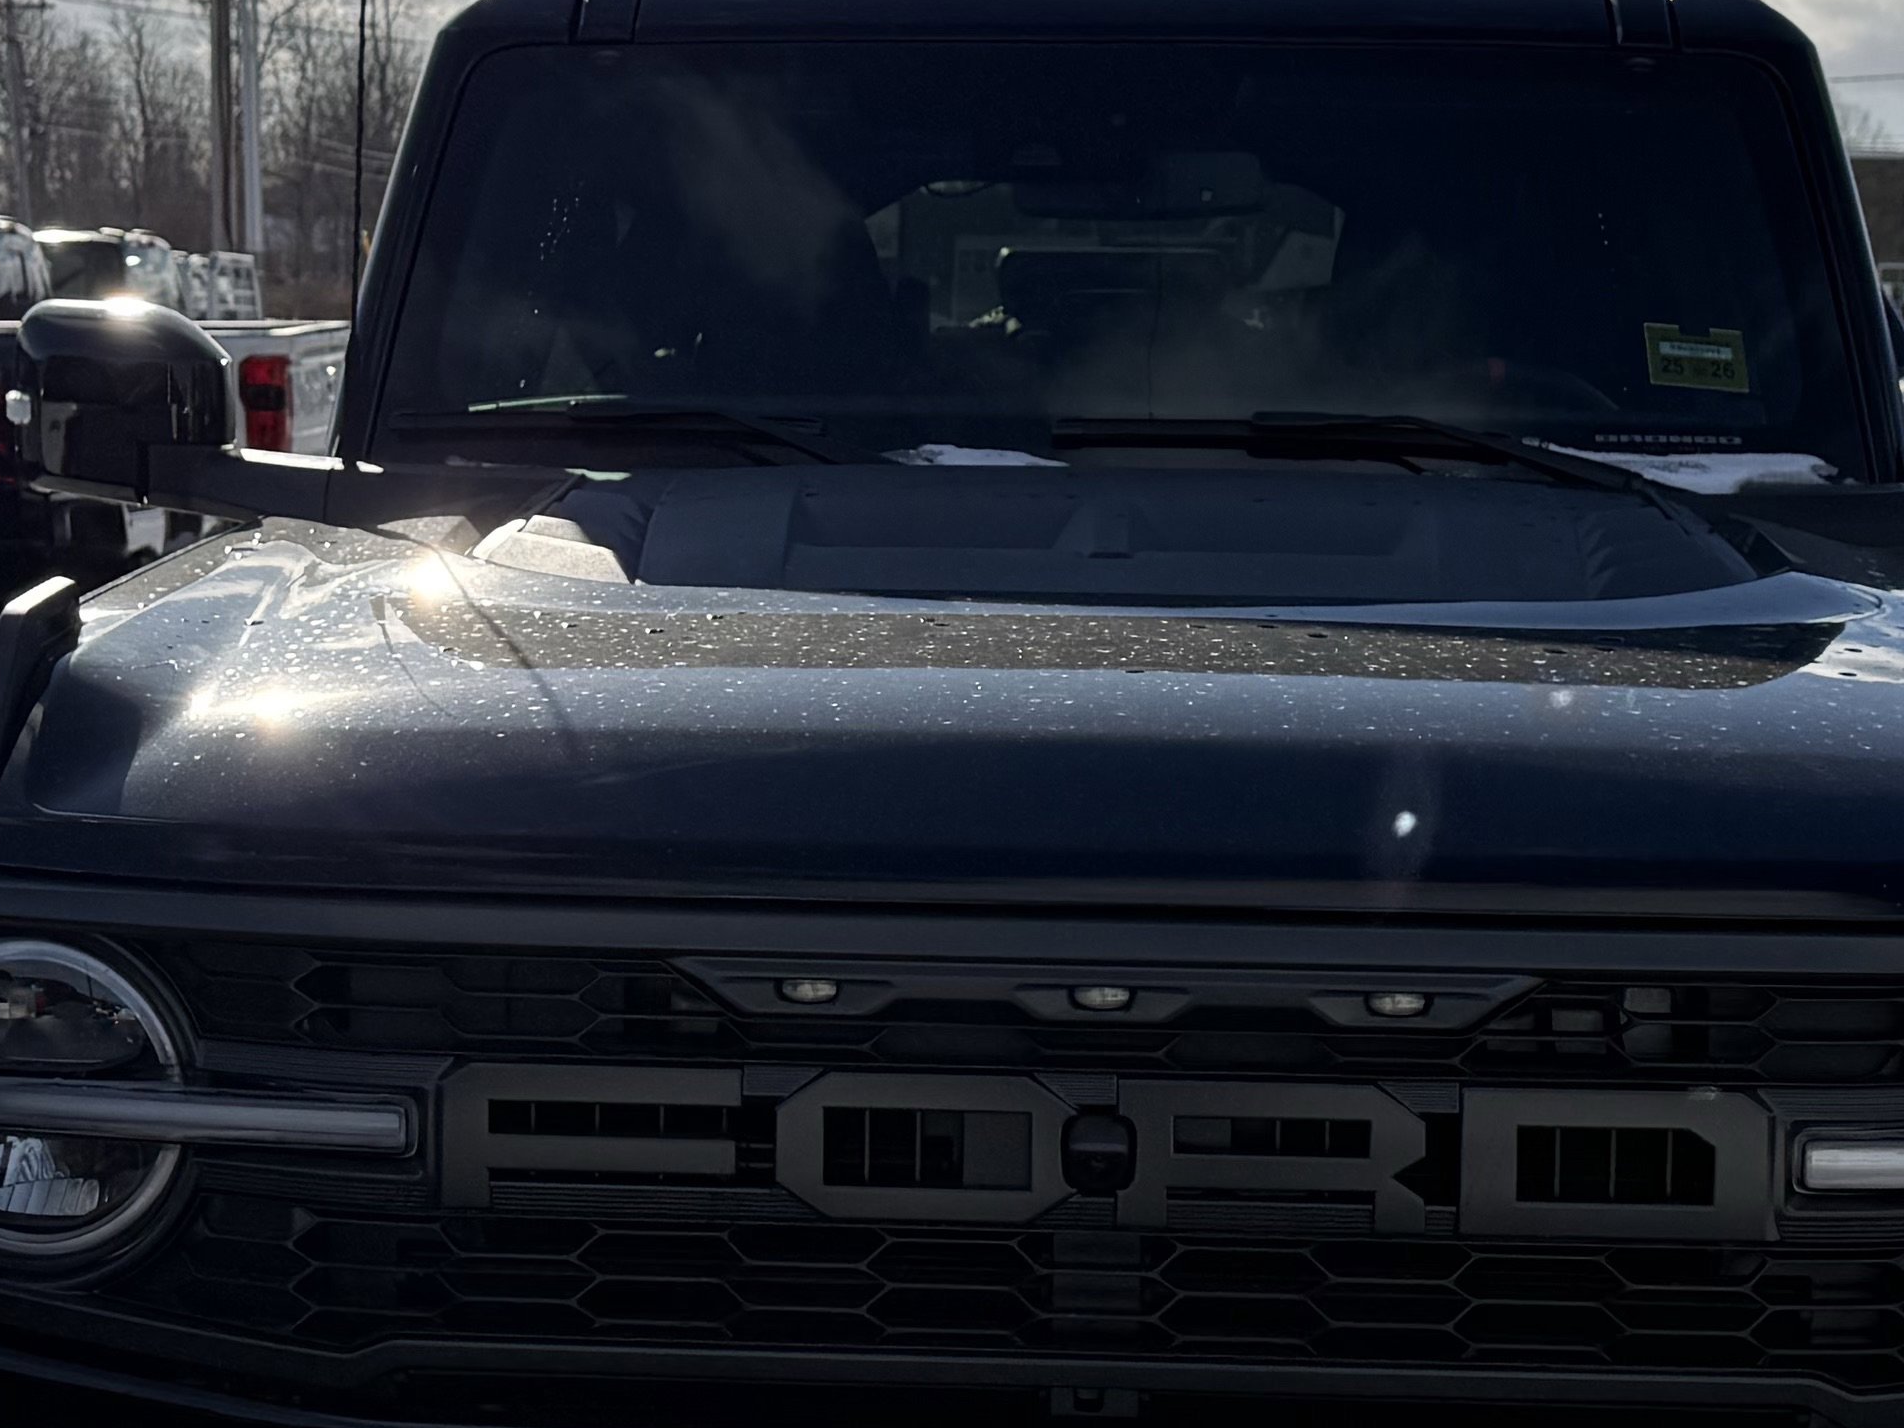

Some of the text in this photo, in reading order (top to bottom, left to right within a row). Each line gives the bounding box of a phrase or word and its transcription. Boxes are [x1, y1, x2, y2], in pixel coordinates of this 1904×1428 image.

[1661, 356, 1735, 380] 25 26
[1594, 433, 1743, 446] BRONCO
[440, 1066, 1773, 1241] FORD
